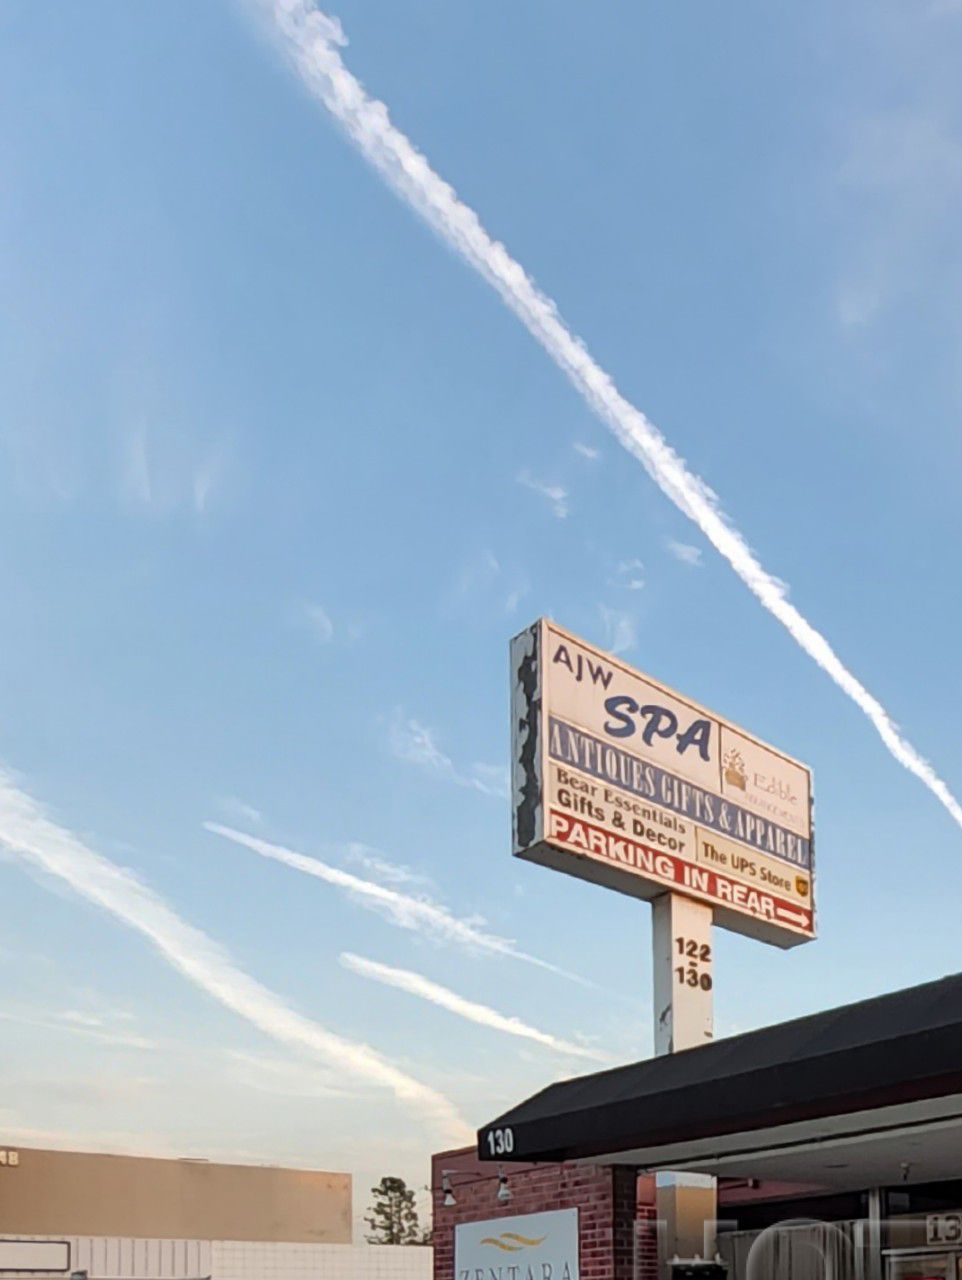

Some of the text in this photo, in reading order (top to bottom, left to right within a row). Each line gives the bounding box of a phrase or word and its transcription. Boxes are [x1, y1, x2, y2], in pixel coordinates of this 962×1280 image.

[553, 644, 613, 691] AJW
[604, 695, 711, 762] SPA
[550, 722, 656, 798] ANTIQUES
[661, 773, 715, 824] GIFTS
[719, 801, 732, 833] &
[734, 809, 808, 866] APPAREL
[556, 767, 686, 835] Bear Essentials
[557, 788, 686, 853] Gifts & Decor
[549, 812, 775, 920] PARKING IN REAR
[702, 840, 791, 892] The UPS Store
[675, 936, 712, 963] 122
[675, 966, 713, 992] 130
[487, 1128, 514, 1156] 130
